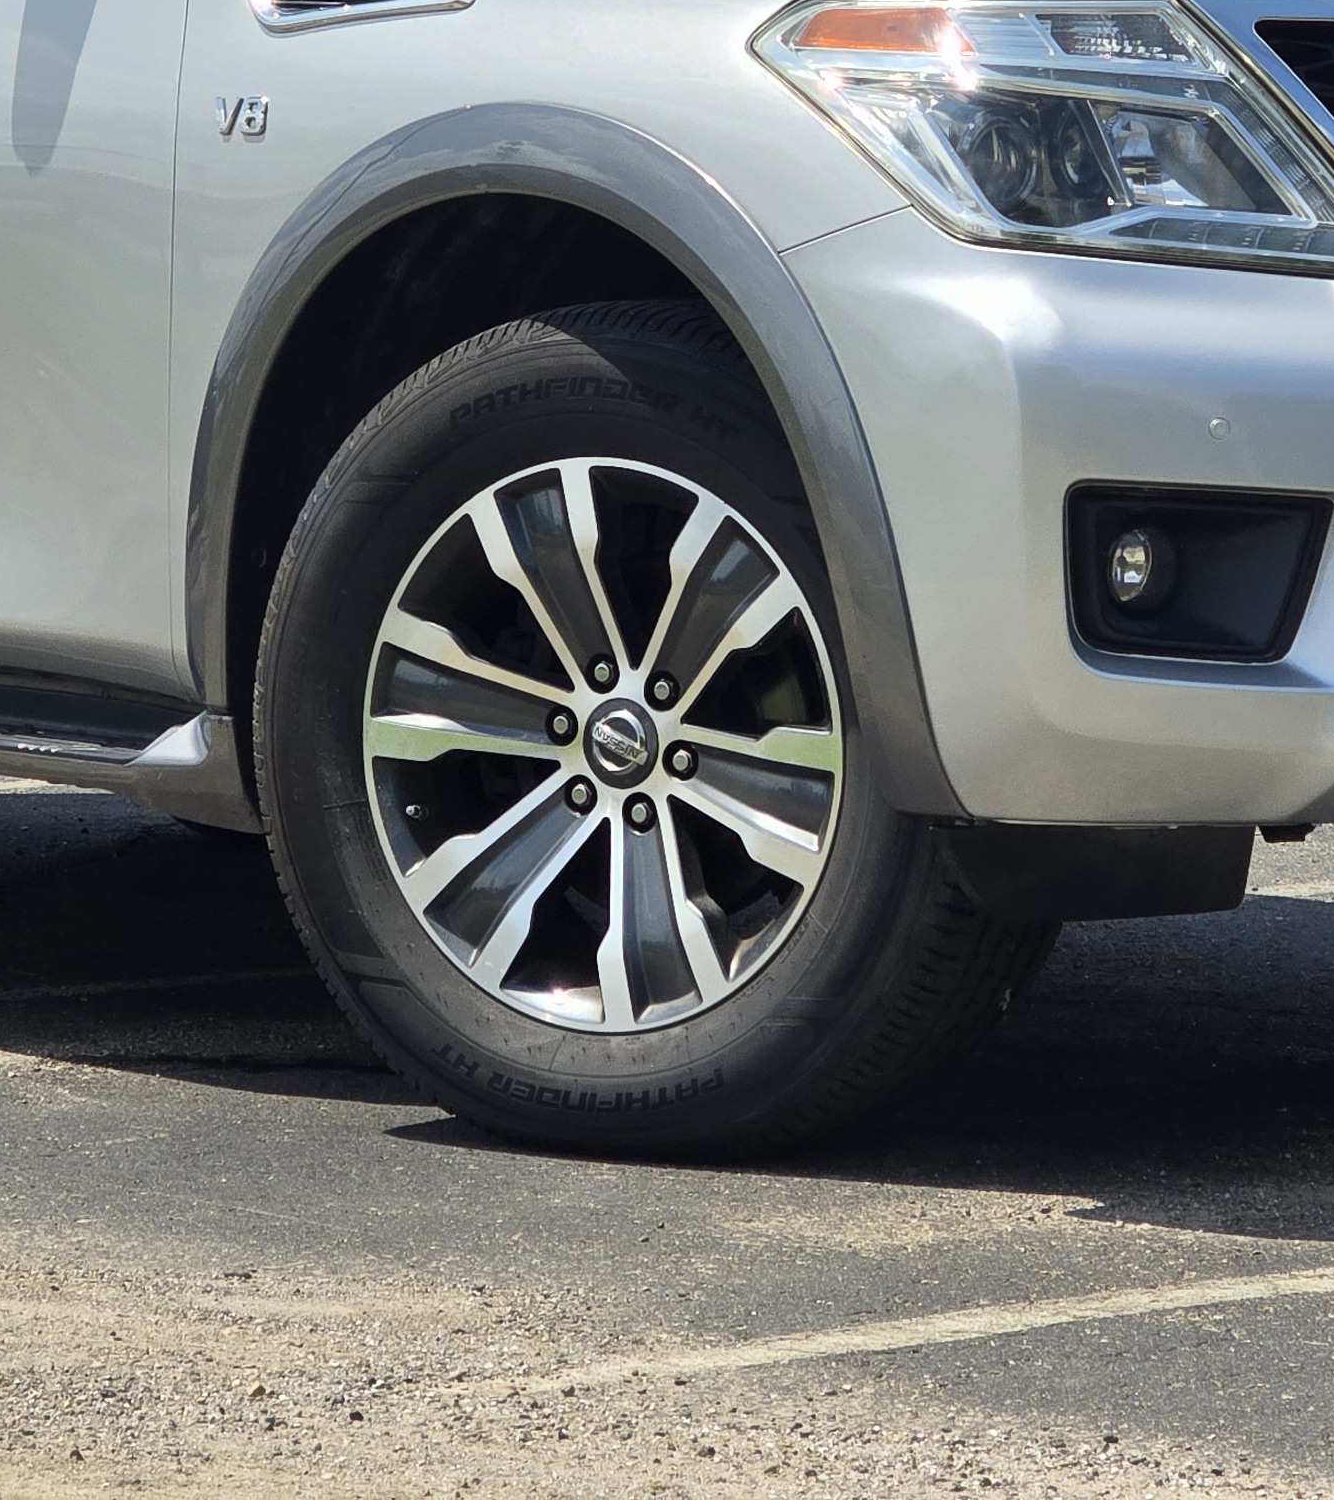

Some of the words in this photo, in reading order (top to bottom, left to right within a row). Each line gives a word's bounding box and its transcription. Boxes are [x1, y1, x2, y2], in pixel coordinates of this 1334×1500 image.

[214, 96, 270, 136] V8
[449, 376, 679, 432] PATHFINDER
[593, 725, 640, 760] NISSAN
[486, 1068, 726, 1114] PATHFINDER
